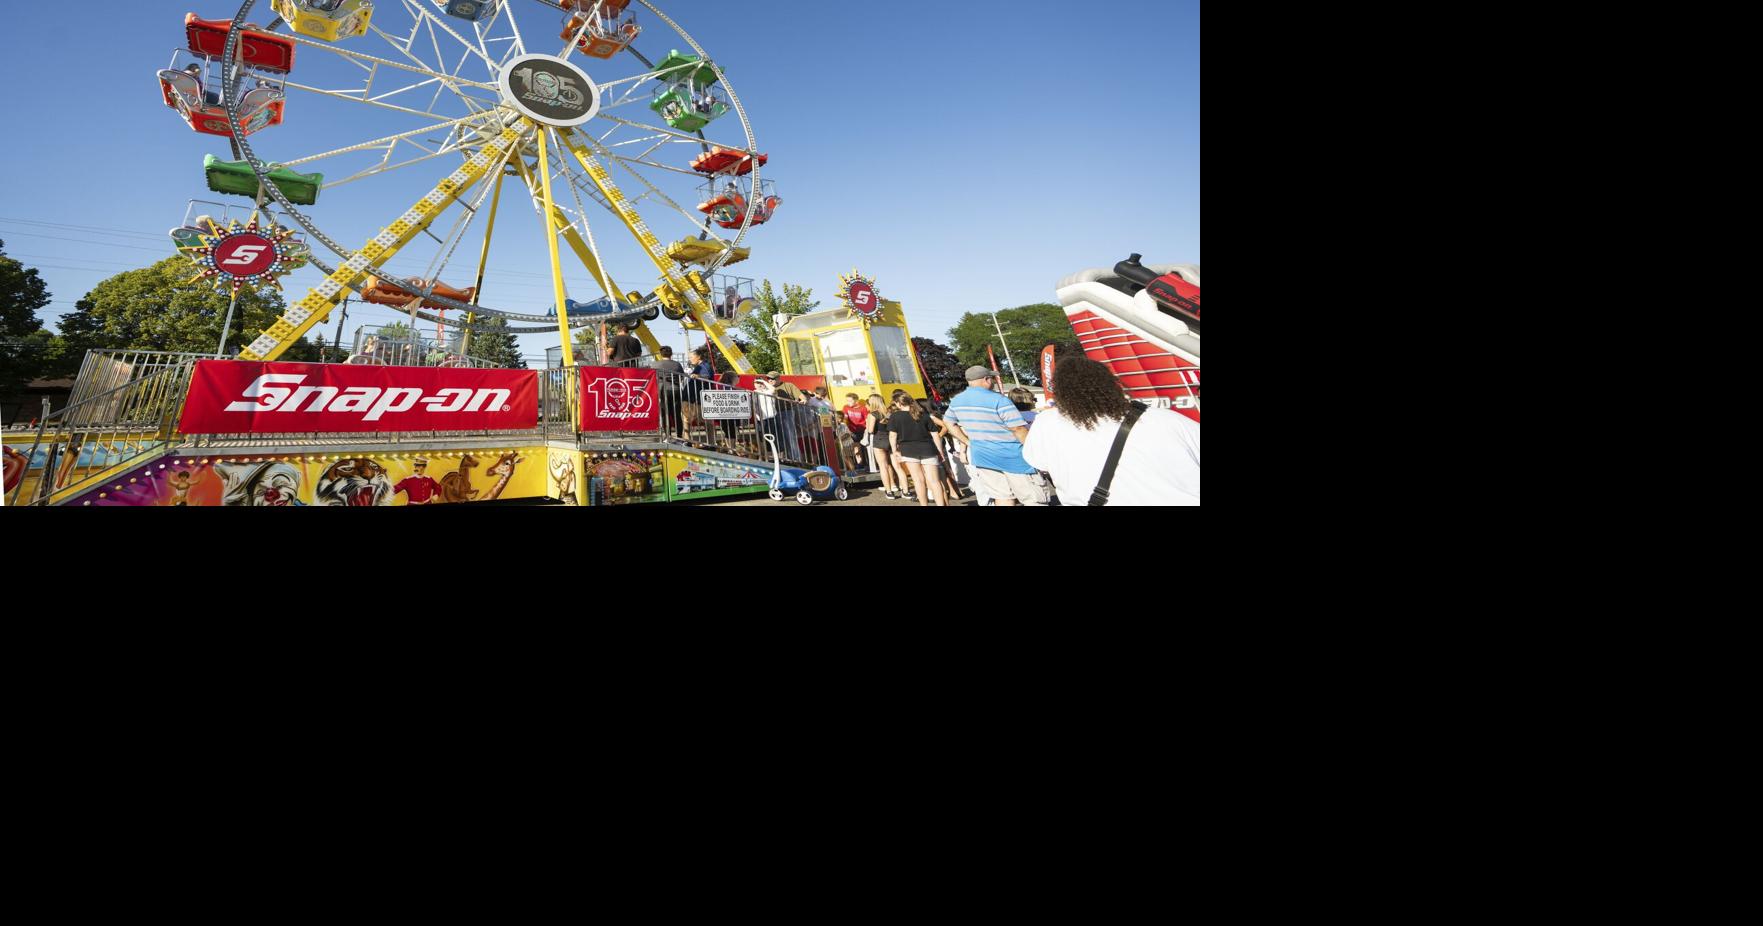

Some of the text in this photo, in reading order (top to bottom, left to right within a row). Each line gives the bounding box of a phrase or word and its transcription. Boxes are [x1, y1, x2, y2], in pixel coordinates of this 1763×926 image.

[514, 67, 584, 106] 105
[588, 378, 652, 417] 105
[597, 409, 649, 420] Snap-on
